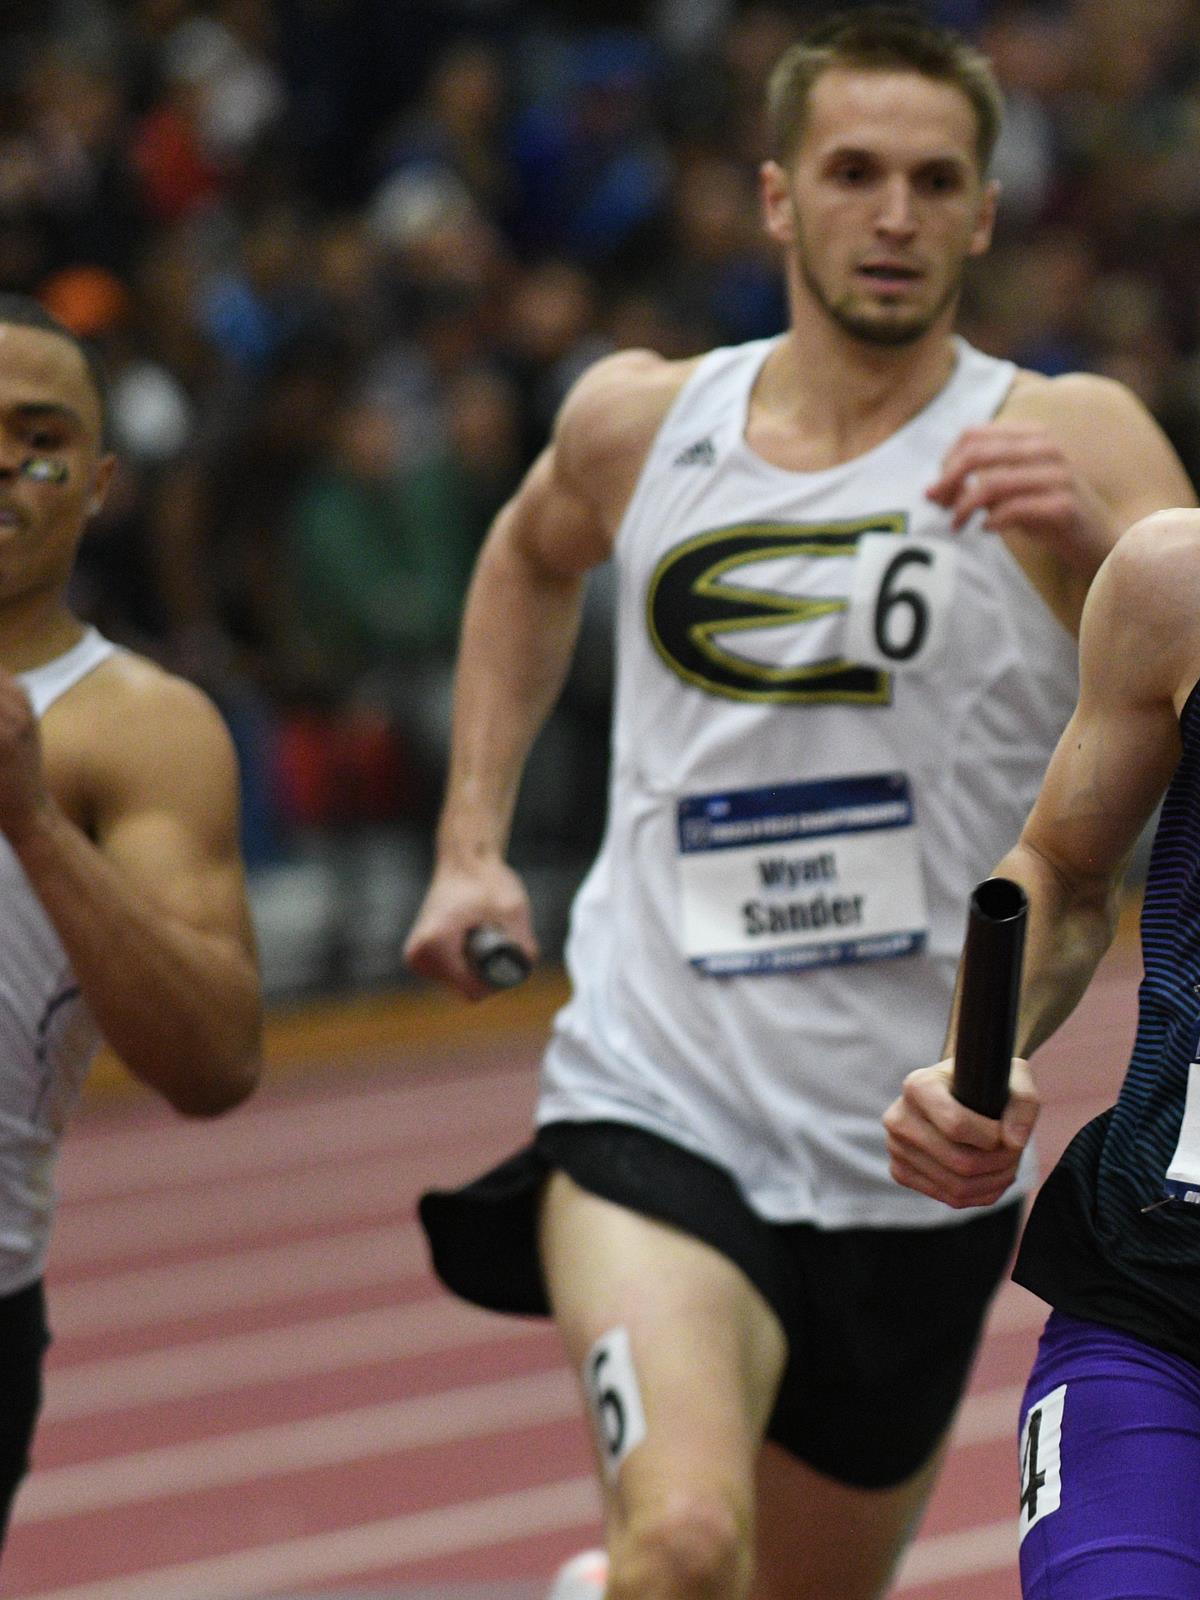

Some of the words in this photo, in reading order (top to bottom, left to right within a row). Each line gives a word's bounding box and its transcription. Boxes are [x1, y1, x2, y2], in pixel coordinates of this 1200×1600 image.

[874, 548, 936, 662] 6
[743, 893, 865, 937] Sander
[593, 1350, 626, 1456] 6
[1020, 1408, 1046, 1524] 4
